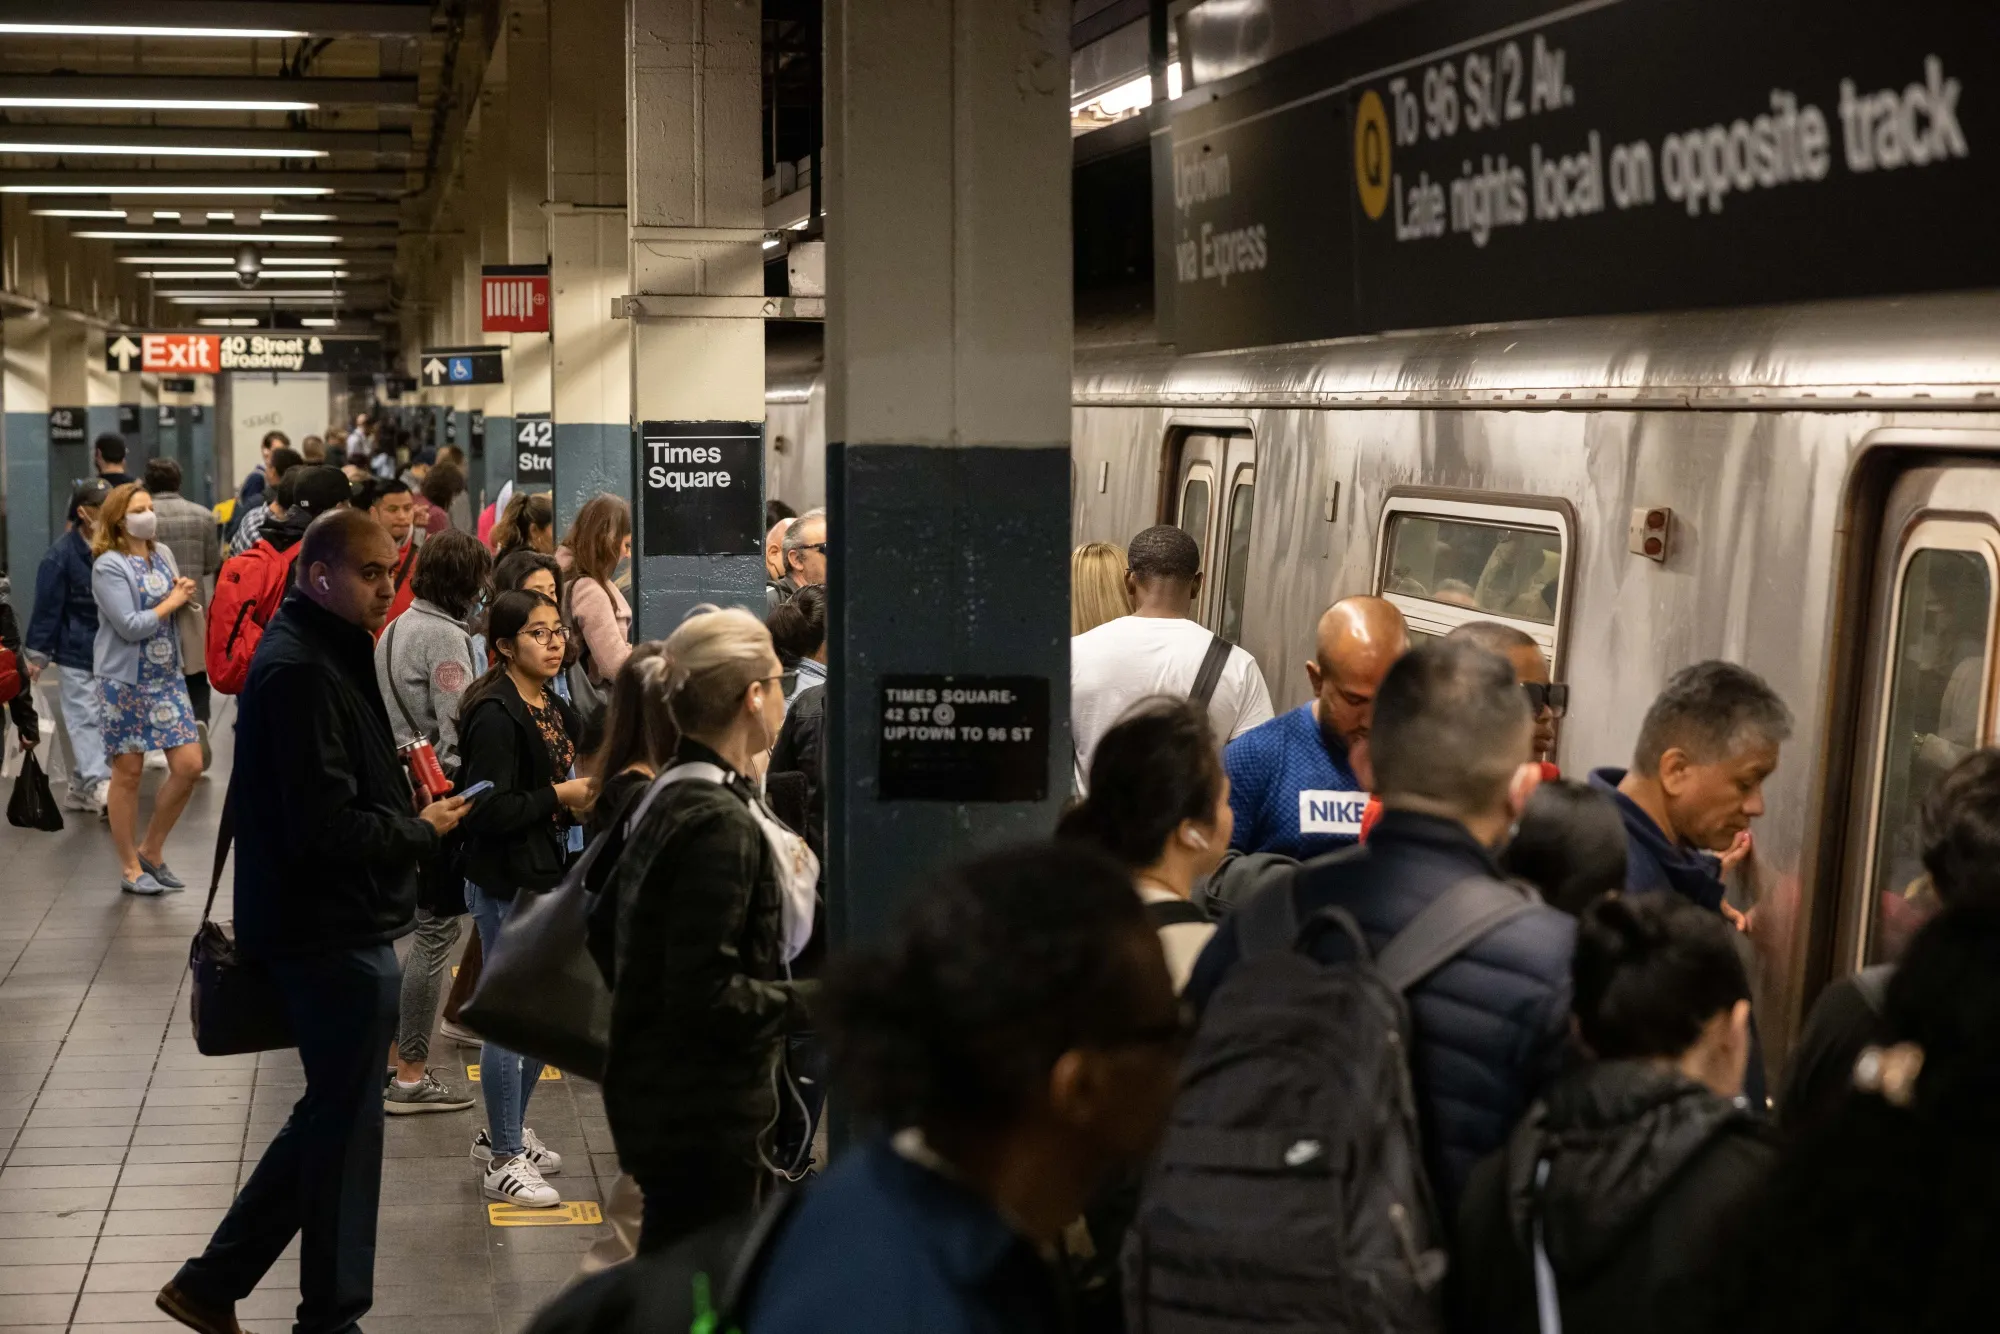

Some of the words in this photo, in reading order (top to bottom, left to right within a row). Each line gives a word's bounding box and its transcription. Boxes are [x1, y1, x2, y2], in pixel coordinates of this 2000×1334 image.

[1388, 77, 1420, 146] To
[1423, 60, 1460, 141] 96
[1530, 33, 1576, 115] Av.
[1394, 170, 1446, 242] Late
[1450, 153, 1528, 248] nights
[1531, 128, 1604, 221] local
[1609, 139, 1655, 210] on
[1660, 87, 1831, 217] opposite
[1837, 53, 1970, 173] track
[1176, 227, 1198, 283] via
[1201, 222, 1268, 288] Express
[143, 336, 211, 369] Exit
[220, 337, 247, 354] 40
[250, 336, 303, 355] Street
[308, 337, 323, 355] &
[220, 353, 304, 371] Broadway
[51, 410, 73, 428] 42
[518, 421, 552, 448] 42
[647, 442, 722, 464] Times
[648, 466, 731, 492] Square
[885, 688, 937, 704] TIMES
[884, 707, 905, 722] 42
[907, 707, 931, 722] ST
[883, 726, 956, 741] UPTOWN
[960, 727, 984, 742] TO
[987, 727, 1007, 742] 96
[1011, 727, 1034, 742] ST
[1308, 799, 1365, 824] NIKE
